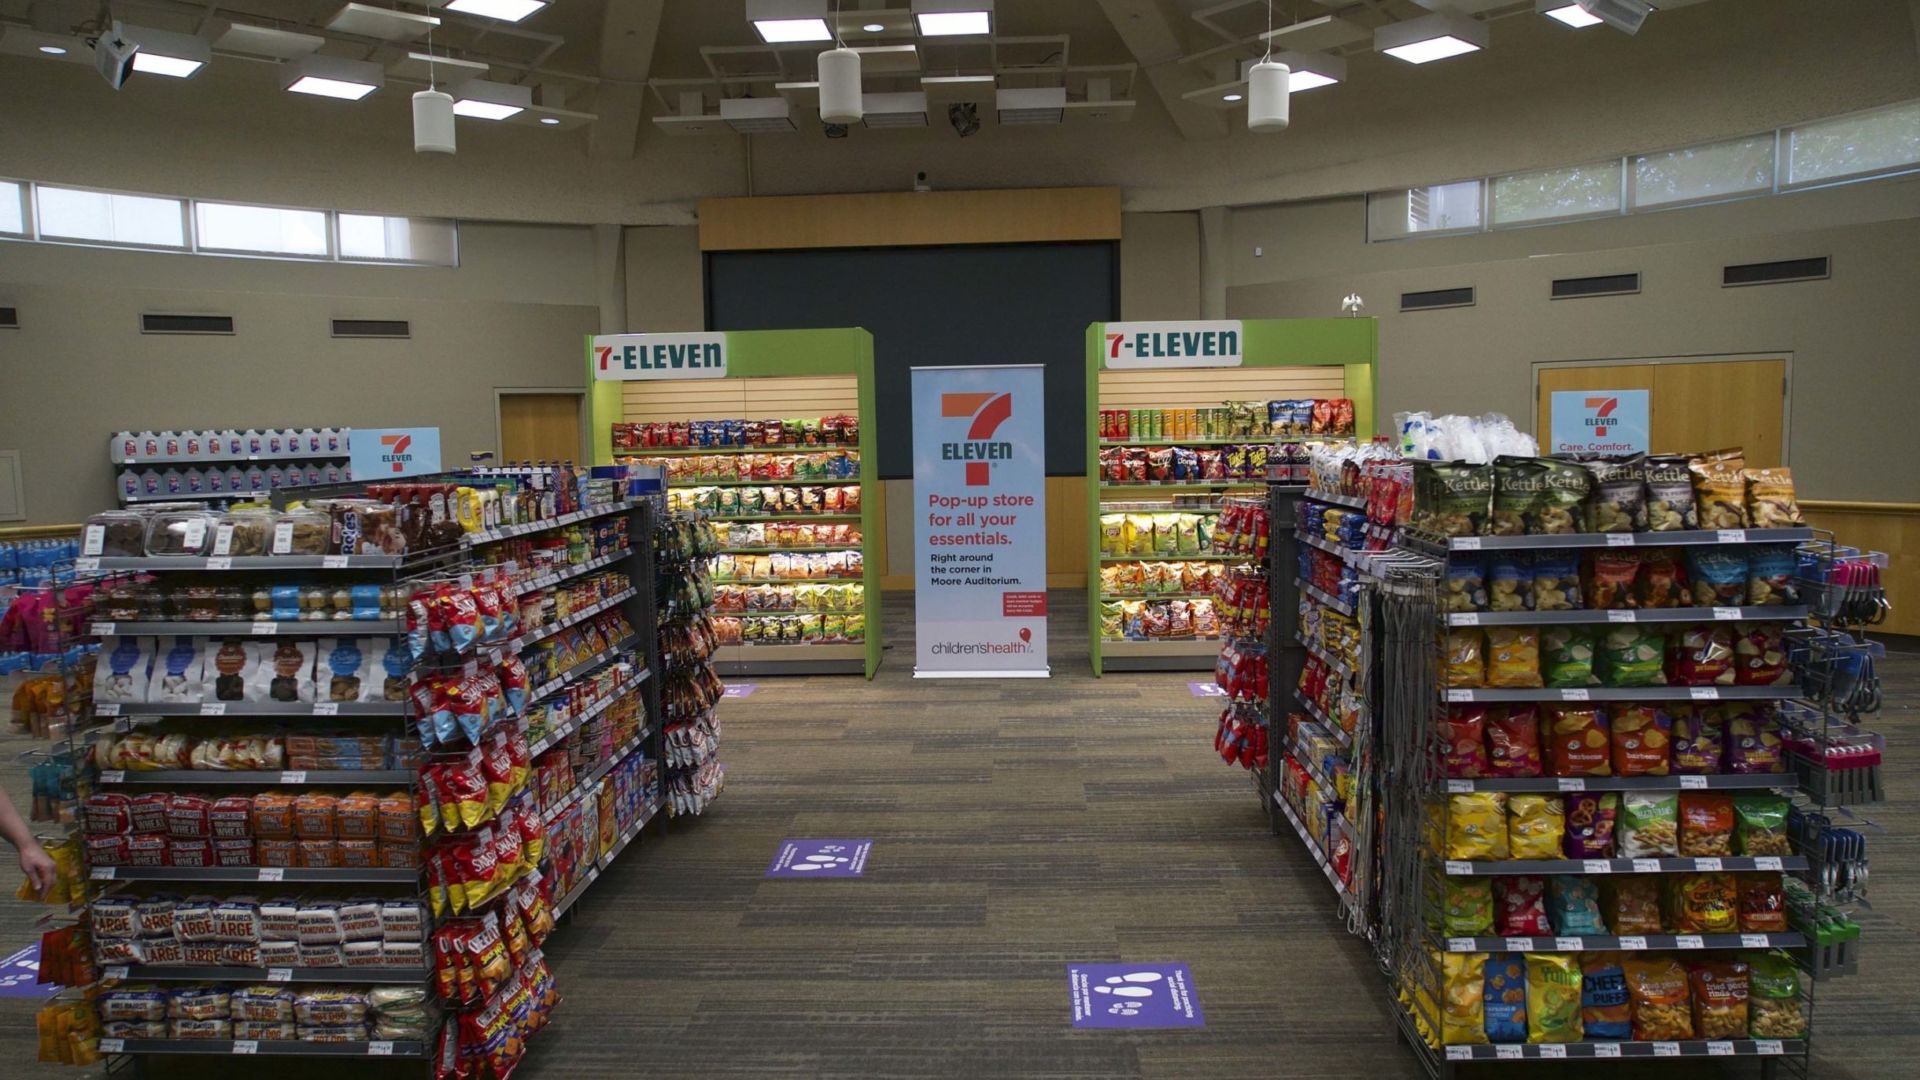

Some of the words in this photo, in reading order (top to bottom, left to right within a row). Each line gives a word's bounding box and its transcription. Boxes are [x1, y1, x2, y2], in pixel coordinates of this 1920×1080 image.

[1559, 443, 1585, 451] Care.
[1588, 442, 1634, 451] Comfort.
[1645, 467, 1690, 482] Kettle
[1444, 477, 1489, 494] Kettle
[1500, 477, 1545, 492] Kettle
[929, 494, 988, 509] Pop-up
[993, 493, 1034, 506] store
[929, 513, 952, 526] for
[957, 512, 975, 526] all
[980, 514, 1016, 528] your
[929, 532, 1012, 546] essentials.
[931, 553, 957, 564] Right
[959, 553, 993, 562] around
[931, 566, 947, 574] the
[983, 565, 991, 573] in
[931, 577, 962, 586] Moore
[964, 576, 1022, 585] Auditorium.
[221, 855, 250, 865] WHEAT
[215, 922, 254, 937] LARGE
[144, 946, 182, 962] LARGE
